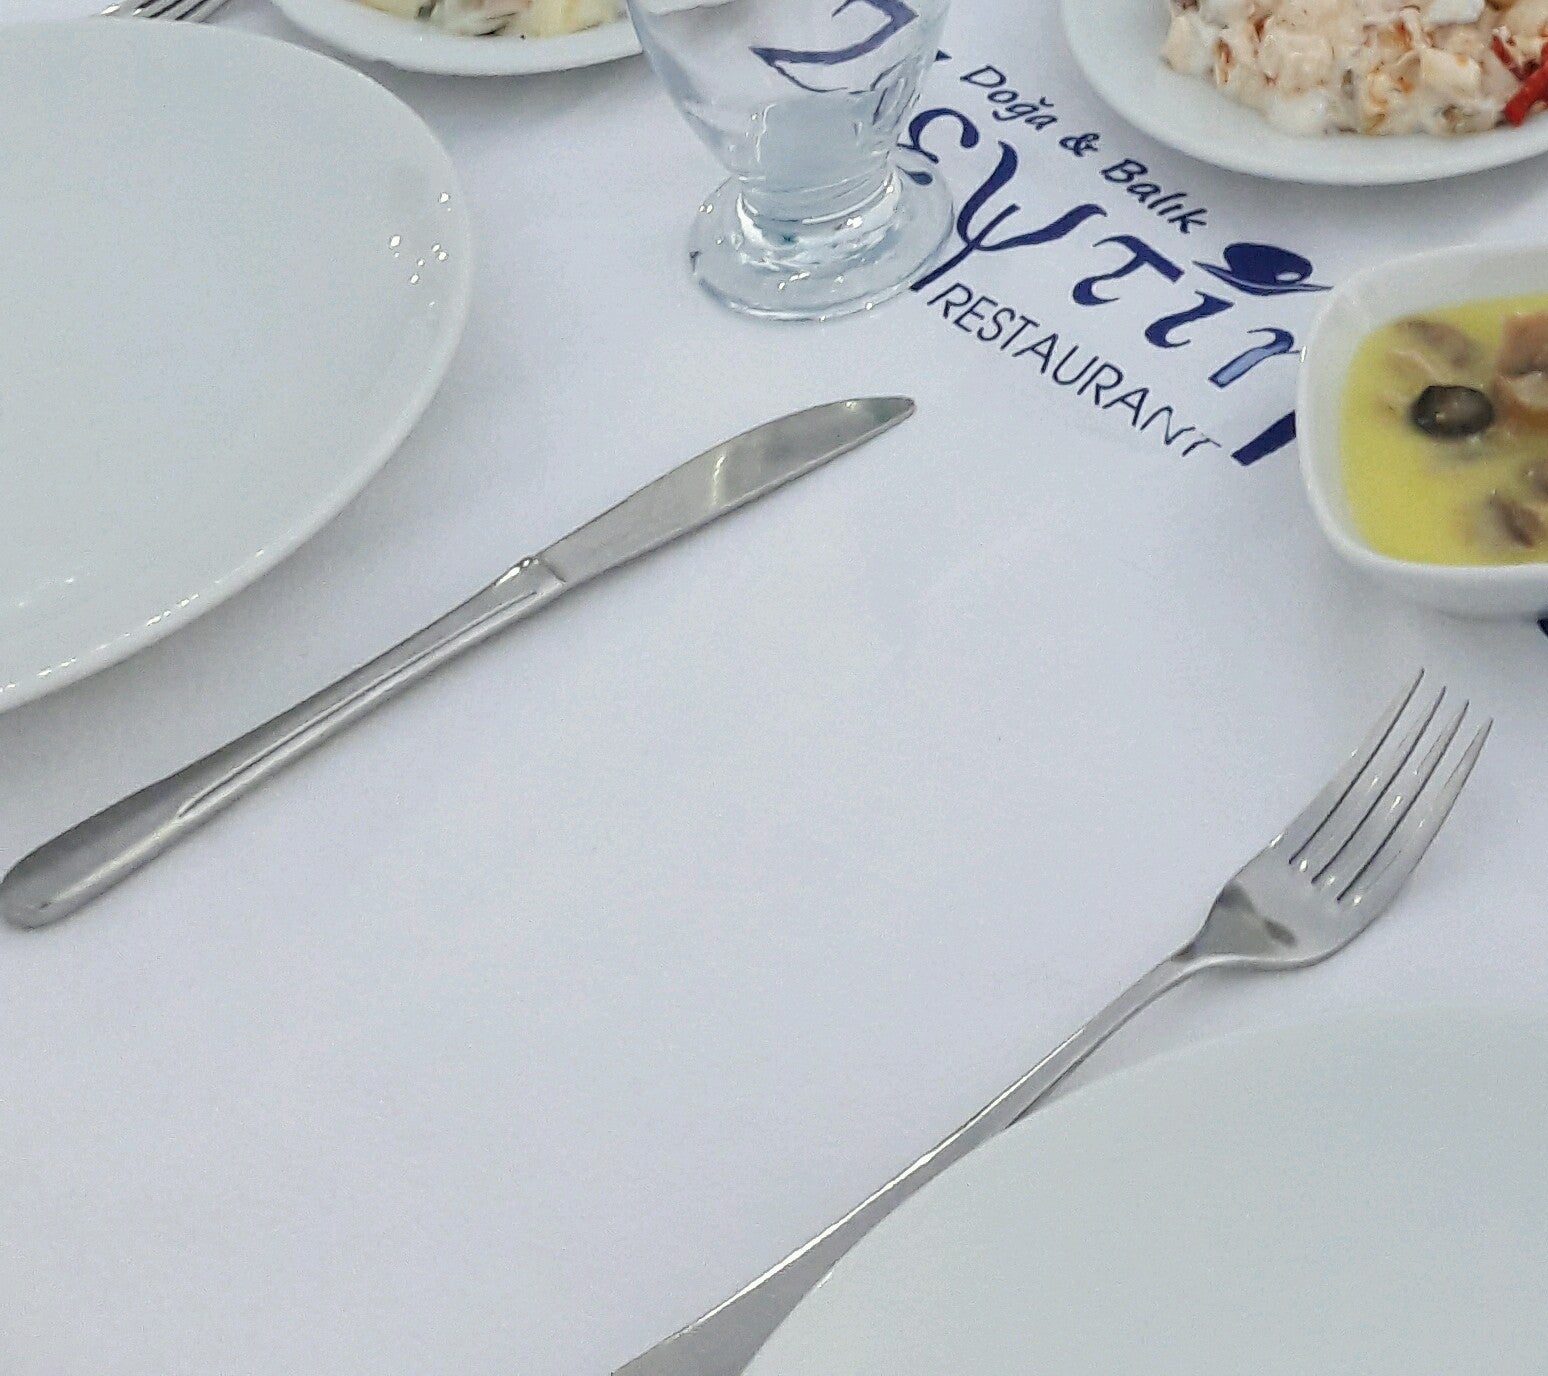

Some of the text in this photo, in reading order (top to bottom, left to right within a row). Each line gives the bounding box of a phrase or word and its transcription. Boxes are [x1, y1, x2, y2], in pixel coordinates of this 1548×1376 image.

[959, 63, 1212, 236] Doğa & Balık
[926, 280, 1225, 459] RESTAURANT
